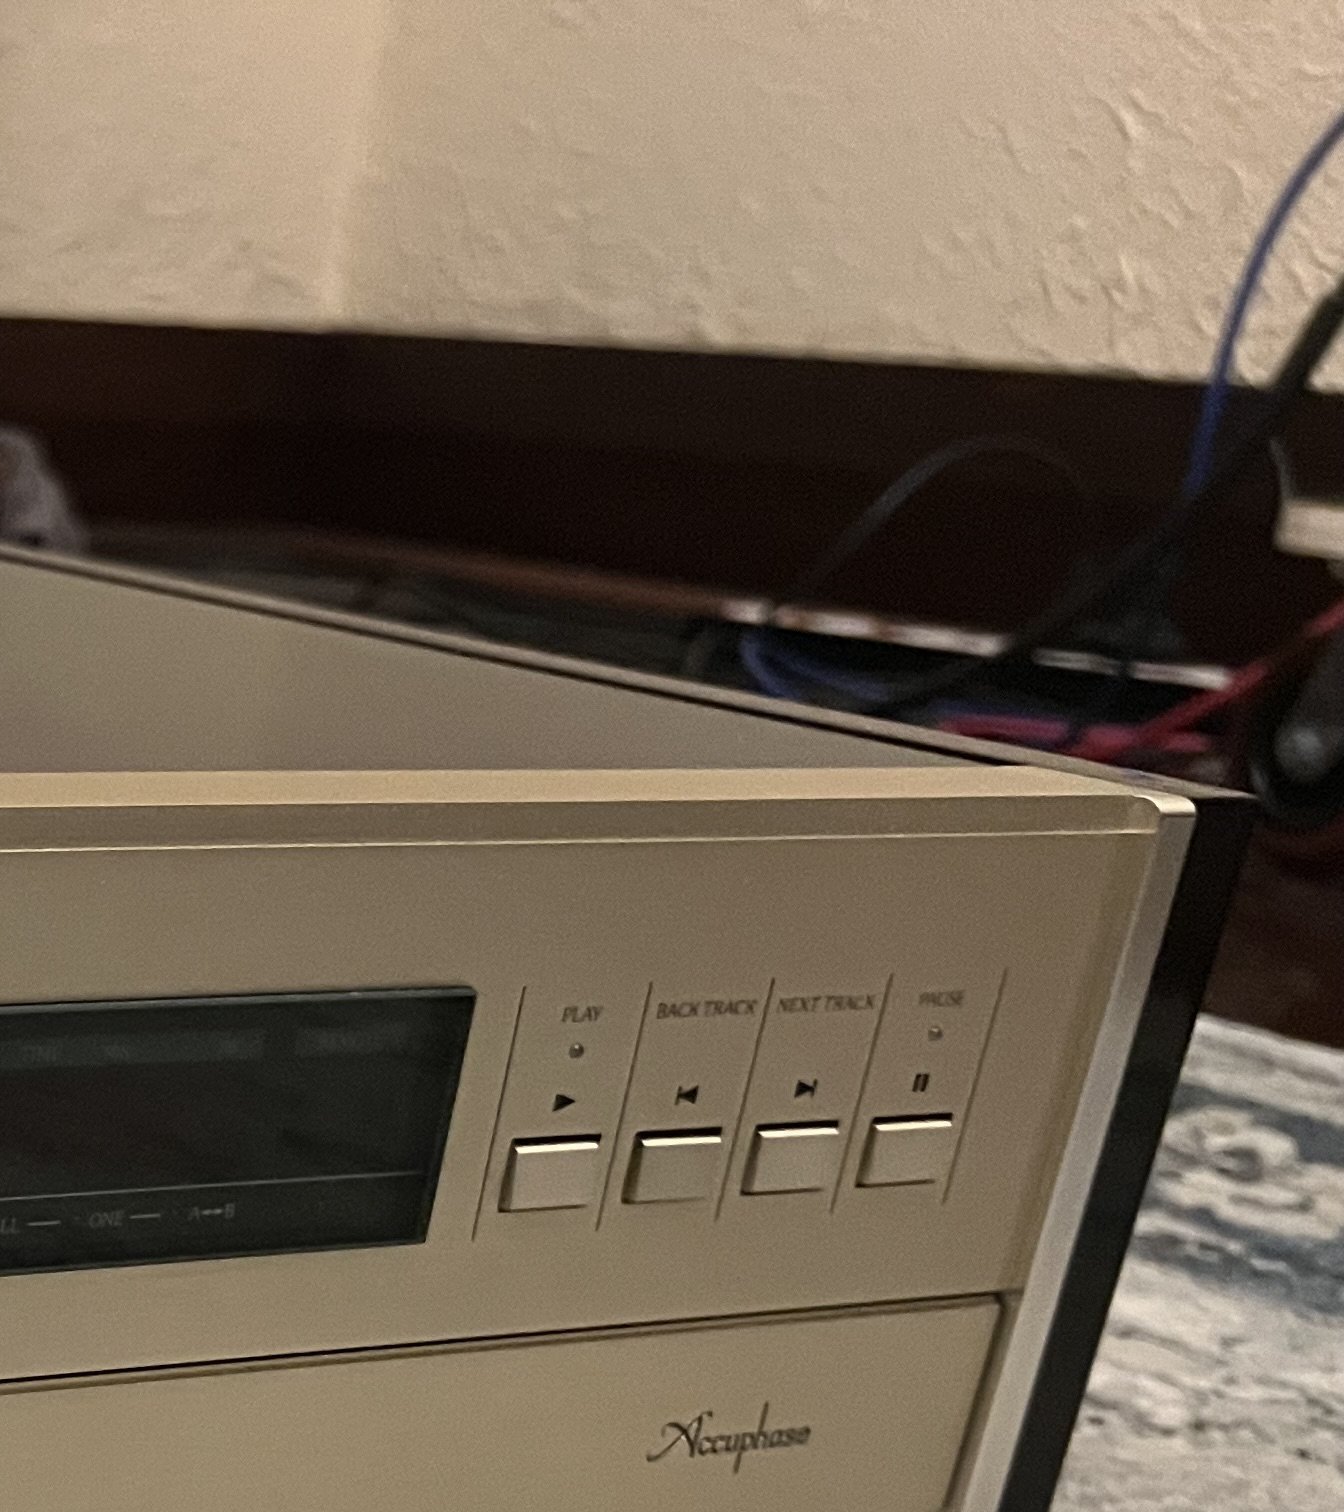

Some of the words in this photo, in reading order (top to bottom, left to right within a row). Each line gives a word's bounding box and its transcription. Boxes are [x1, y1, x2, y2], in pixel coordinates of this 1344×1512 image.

[561, 1005, 605, 1023] PLAY
[655, 1001, 699, 1020] BACK
[703, 999, 759, 1018] TRACK
[776, 996, 822, 1014] NEXT
[824, 994, 877, 1012] TRACK
[87, 1209, 126, 1229] ONE
